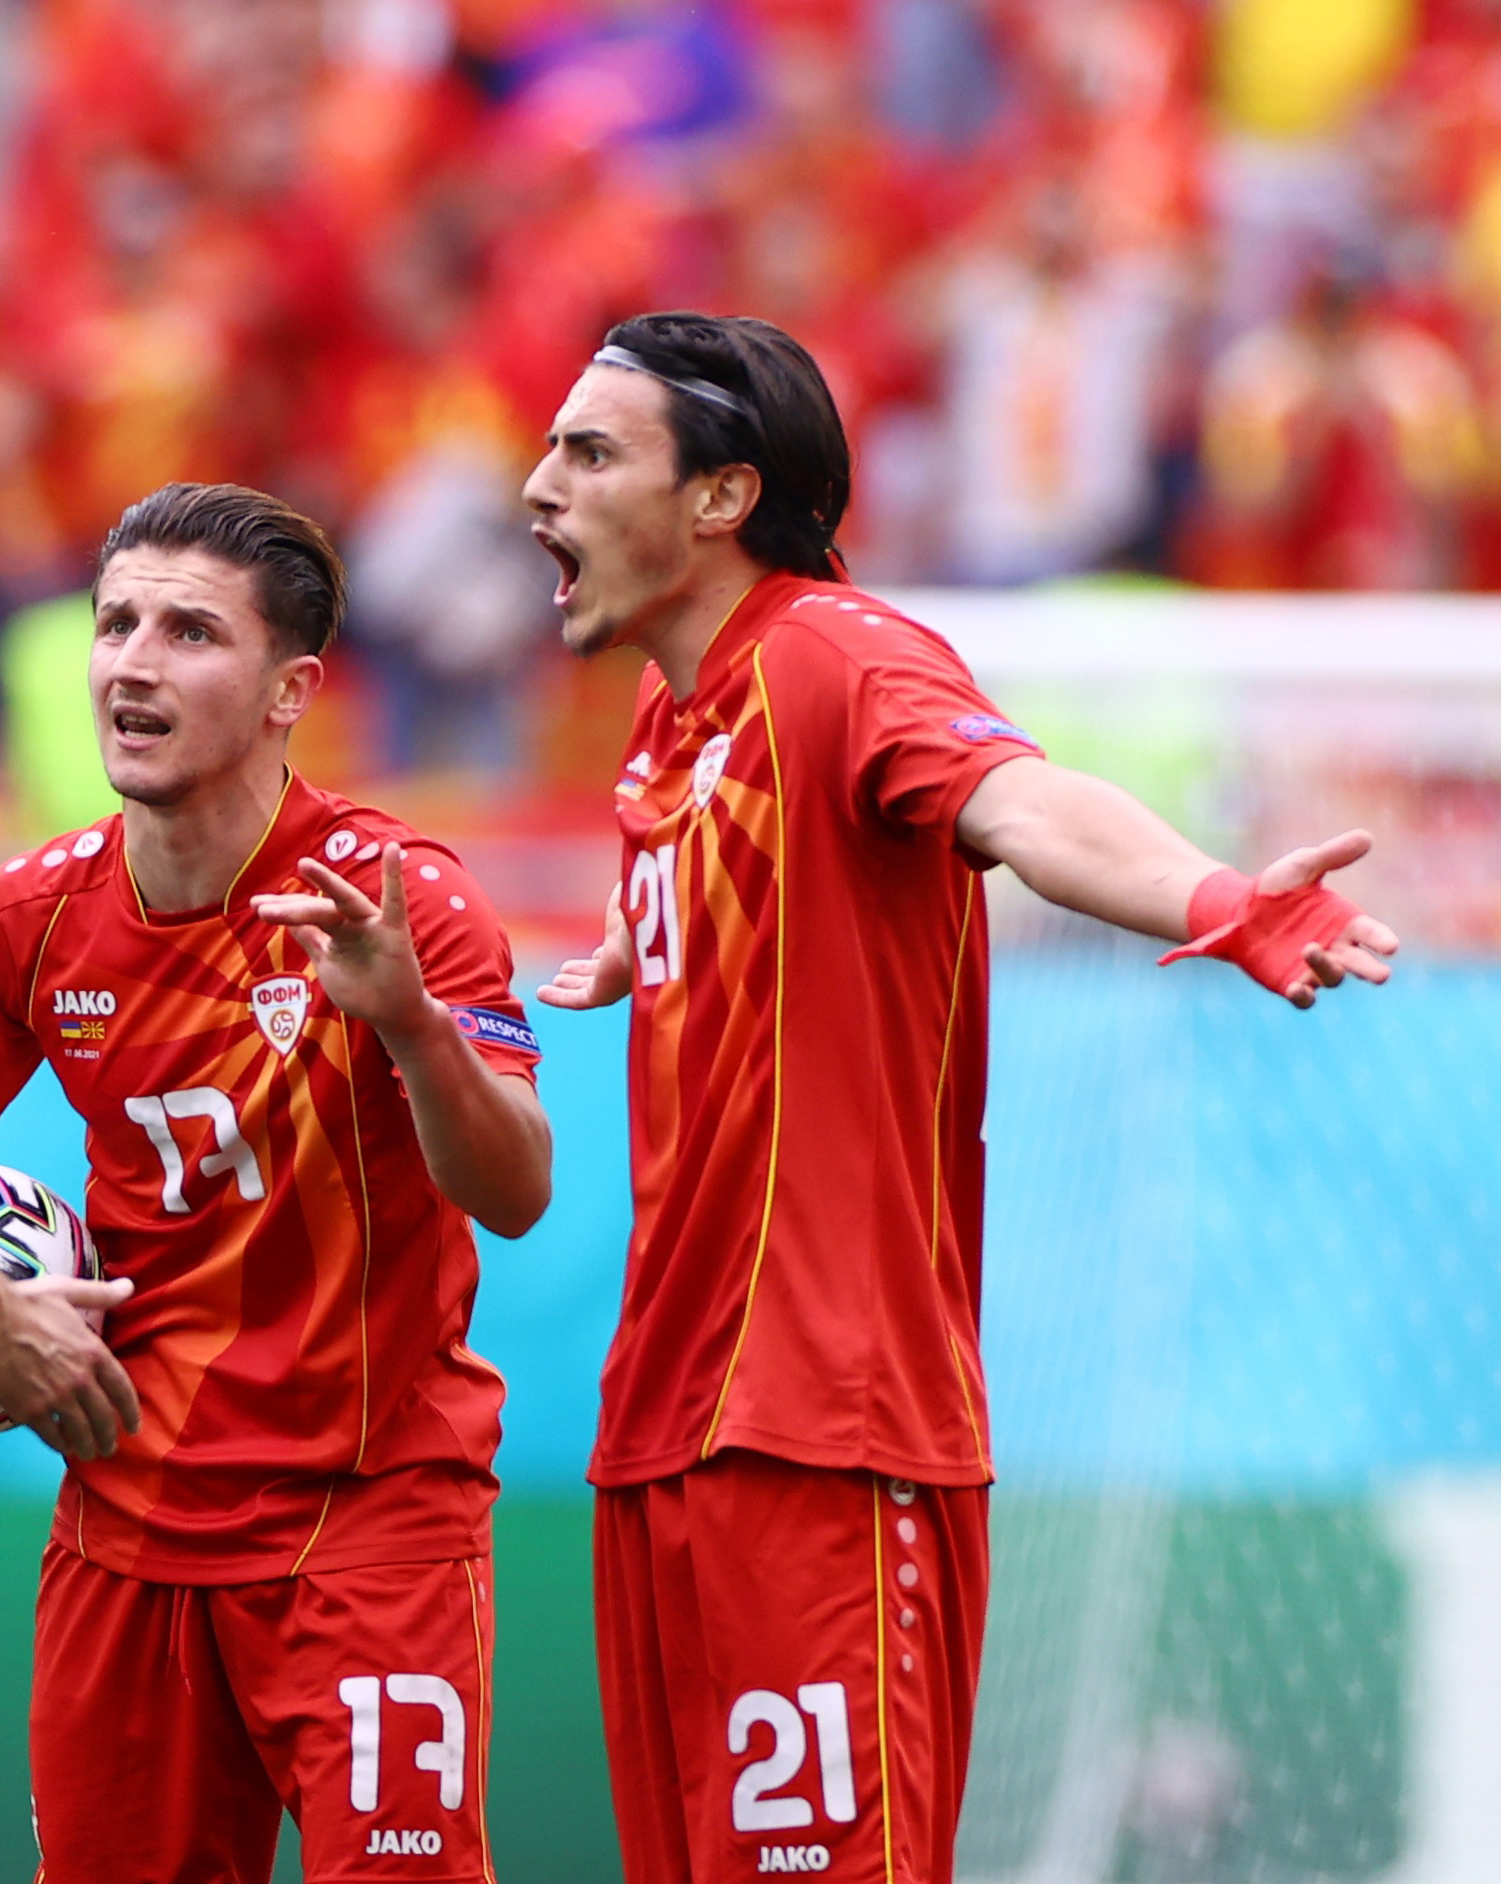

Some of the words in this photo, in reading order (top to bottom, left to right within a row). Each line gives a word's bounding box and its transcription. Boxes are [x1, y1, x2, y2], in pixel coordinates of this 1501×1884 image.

[629, 843, 683, 987] 21
[53, 989, 116, 1016] JAKO
[478, 1015, 538, 1047] RESPECT
[124, 1086, 266, 1214] 17
[338, 1673, 466, 1812] 17
[728, 1681, 857, 1832] 21
[366, 1829, 442, 1855] JAKO
[758, 1844, 830, 1873] JAKO
